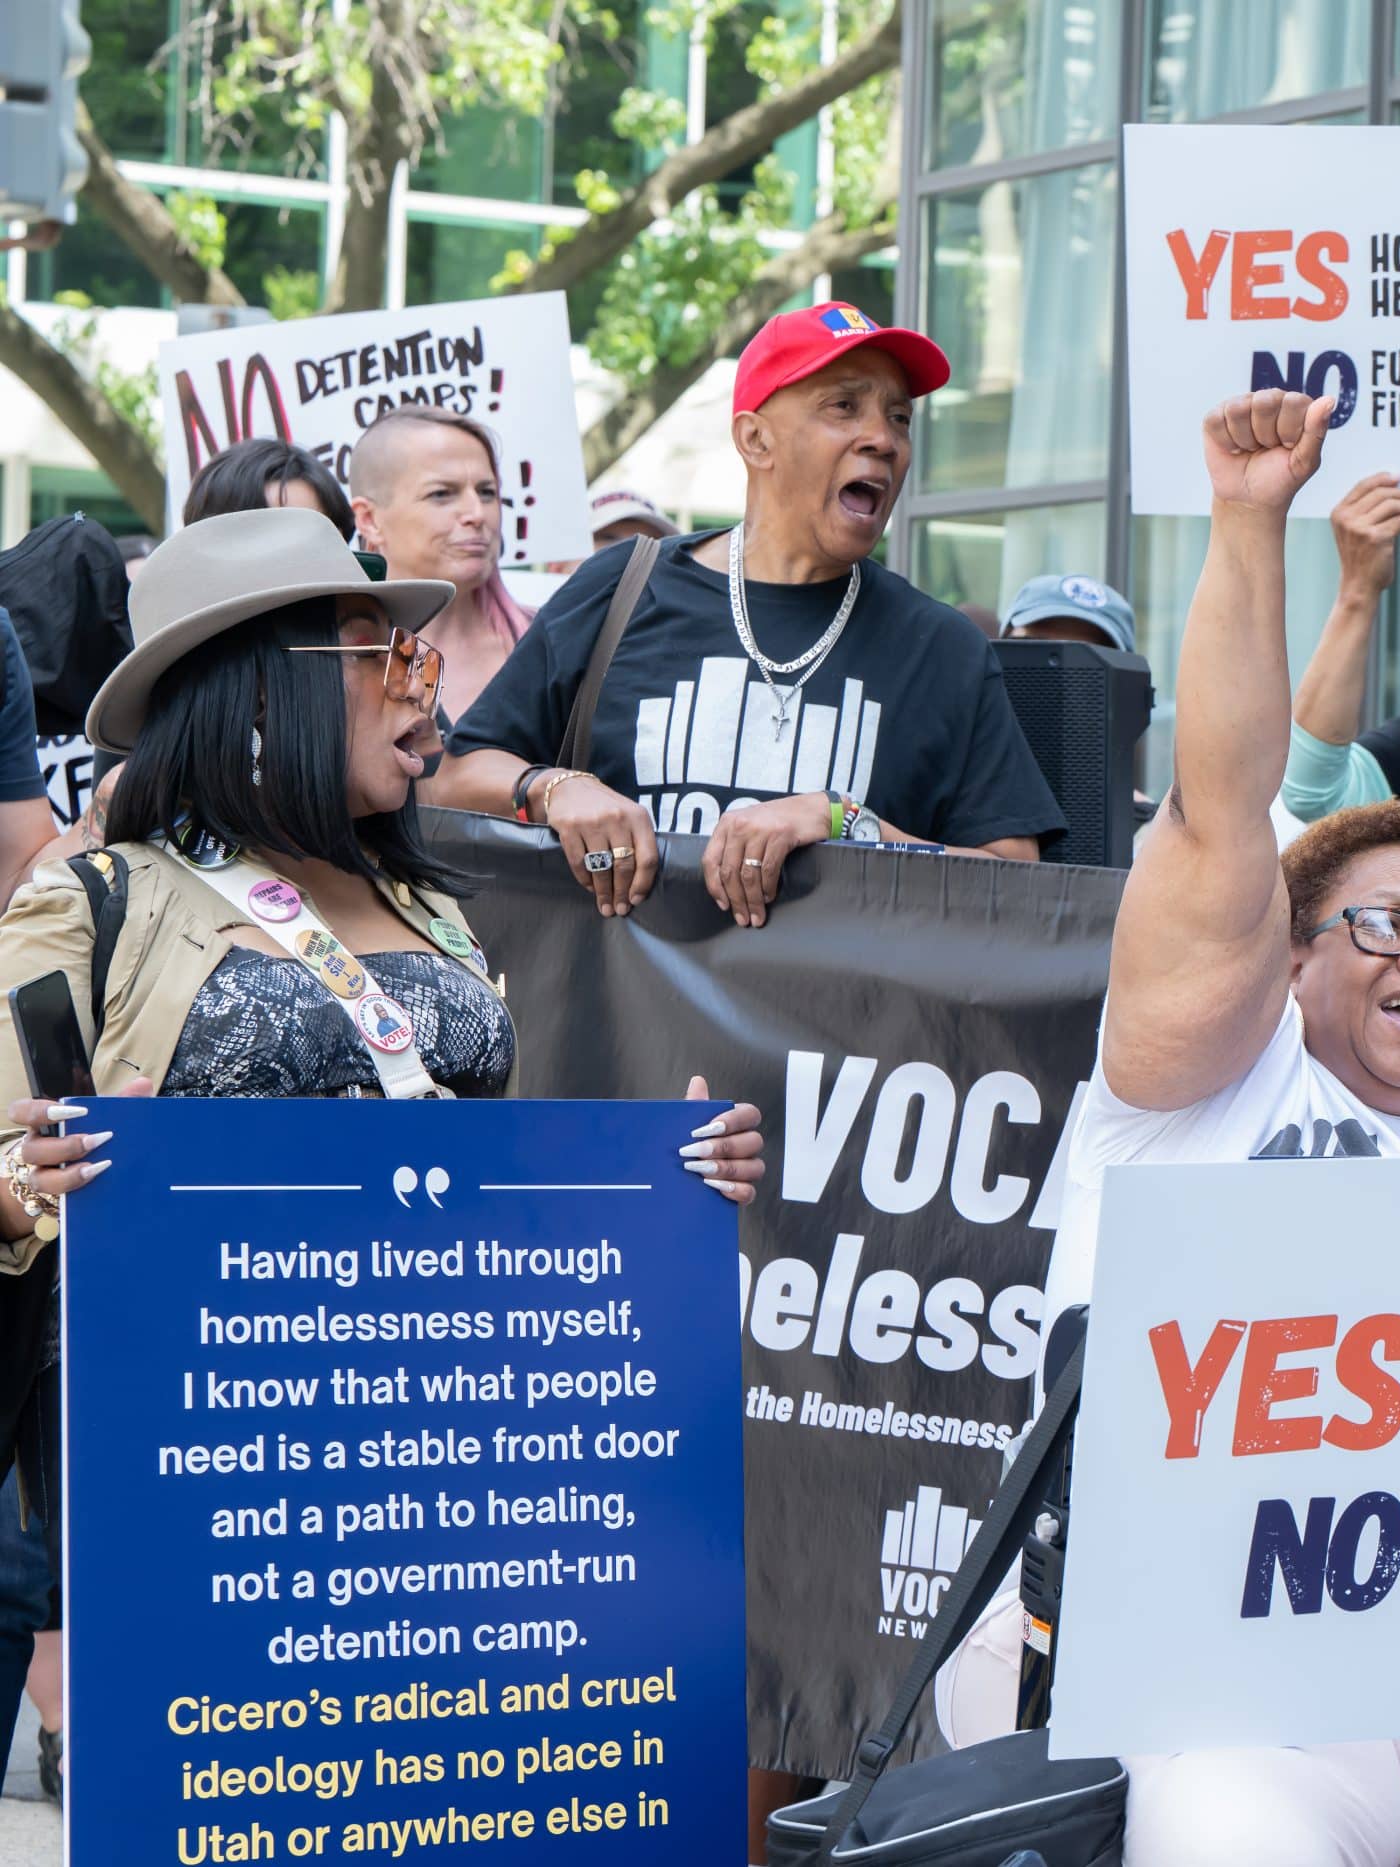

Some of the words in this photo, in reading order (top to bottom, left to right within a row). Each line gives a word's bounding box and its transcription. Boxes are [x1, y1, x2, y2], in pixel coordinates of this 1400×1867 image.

[1165, 228, 1349, 322] YES
[296, 326, 485, 404] DETENTION
[1250, 349, 1358, 430] NO
[176, 352, 294, 482] NO
[379, 1025, 411, 1048] VOTE!
[220, 1241, 359, 1288] Having
[371, 1240, 464, 1277] lived
[475, 1239, 622, 1284] through
[200, 1305, 495, 1345] homelessness
[506, 1300, 641, 1346] myself,
[184, 1372, 193, 1409] I
[207, 1371, 319, 1409] know
[330, 1367, 410, 1405] that
[420, 1364, 515, 1402] what
[527, 1361, 657, 1409] people
[745, 1386, 794, 1423] the
[800, 1391, 1013, 1451] Homelessness
[159, 1434, 265, 1475] need
[278, 1433, 311, 1471] is
[323, 1441, 346, 1470] a
[358, 1428, 482, 1468] stable
[492, 1424, 583, 1463] front
[594, 1423, 680, 1459] door
[211, 1498, 287, 1538] and
[300, 1505, 323, 1534] a
[336, 1493, 424, 1542] path
[435, 1491, 476, 1528] to
[487, 1486, 635, 1530] healing,
[212, 1563, 280, 1603] not
[292, 1570, 315, 1599] a
[327, 1549, 636, 1606] government-run
[268, 1619, 461, 1665] detention
[472, 1619, 587, 1656] camp.
[878, 1615, 929, 1640] NEW
[355, 1678, 490, 1723] radical
[500, 1673, 569, 1713] and
[581, 1666, 677, 1708] cruel
[182, 1755, 364, 1800] ideology
[375, 1748, 445, 1786] has
[457, 1749, 505, 1779] no
[517, 1737, 622, 1784] place
[633, 1729, 664, 1766] in
[178, 1822, 275, 1866] Utah
[287, 1825, 331, 1857] or
[342, 1807, 535, 1857] anywhere
[546, 1797, 627, 1835] else
[638, 1791, 668, 1827] in
